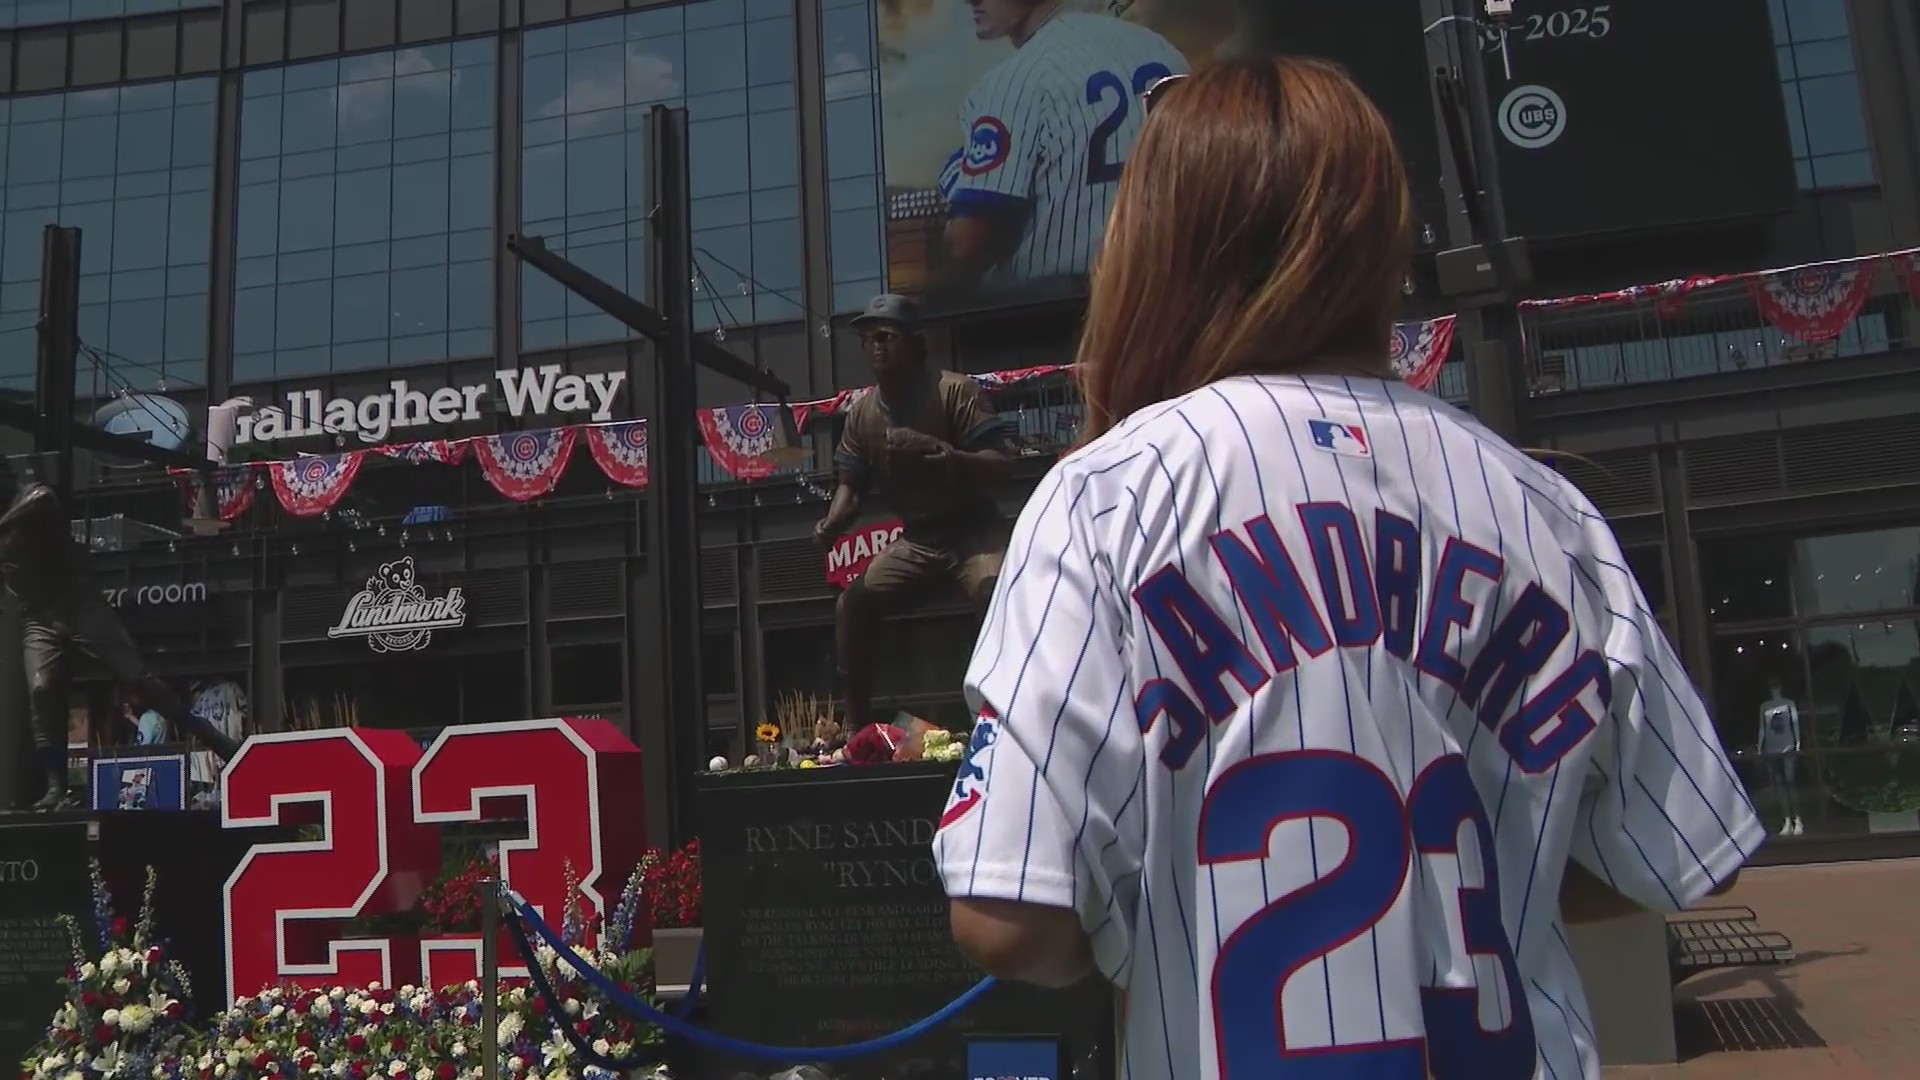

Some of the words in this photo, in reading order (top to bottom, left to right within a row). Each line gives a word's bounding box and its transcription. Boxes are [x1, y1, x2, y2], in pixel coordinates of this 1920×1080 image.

[496, 364, 626, 421] Way
[137, 582, 207, 606] room
[333, 587, 466, 634] Landmark
[1133, 501, 1612, 775] SANDBERG
[221, 717, 606, 1012] 23
[745, 824, 834, 852] RYNE
[1197, 749, 1537, 1080] 23
